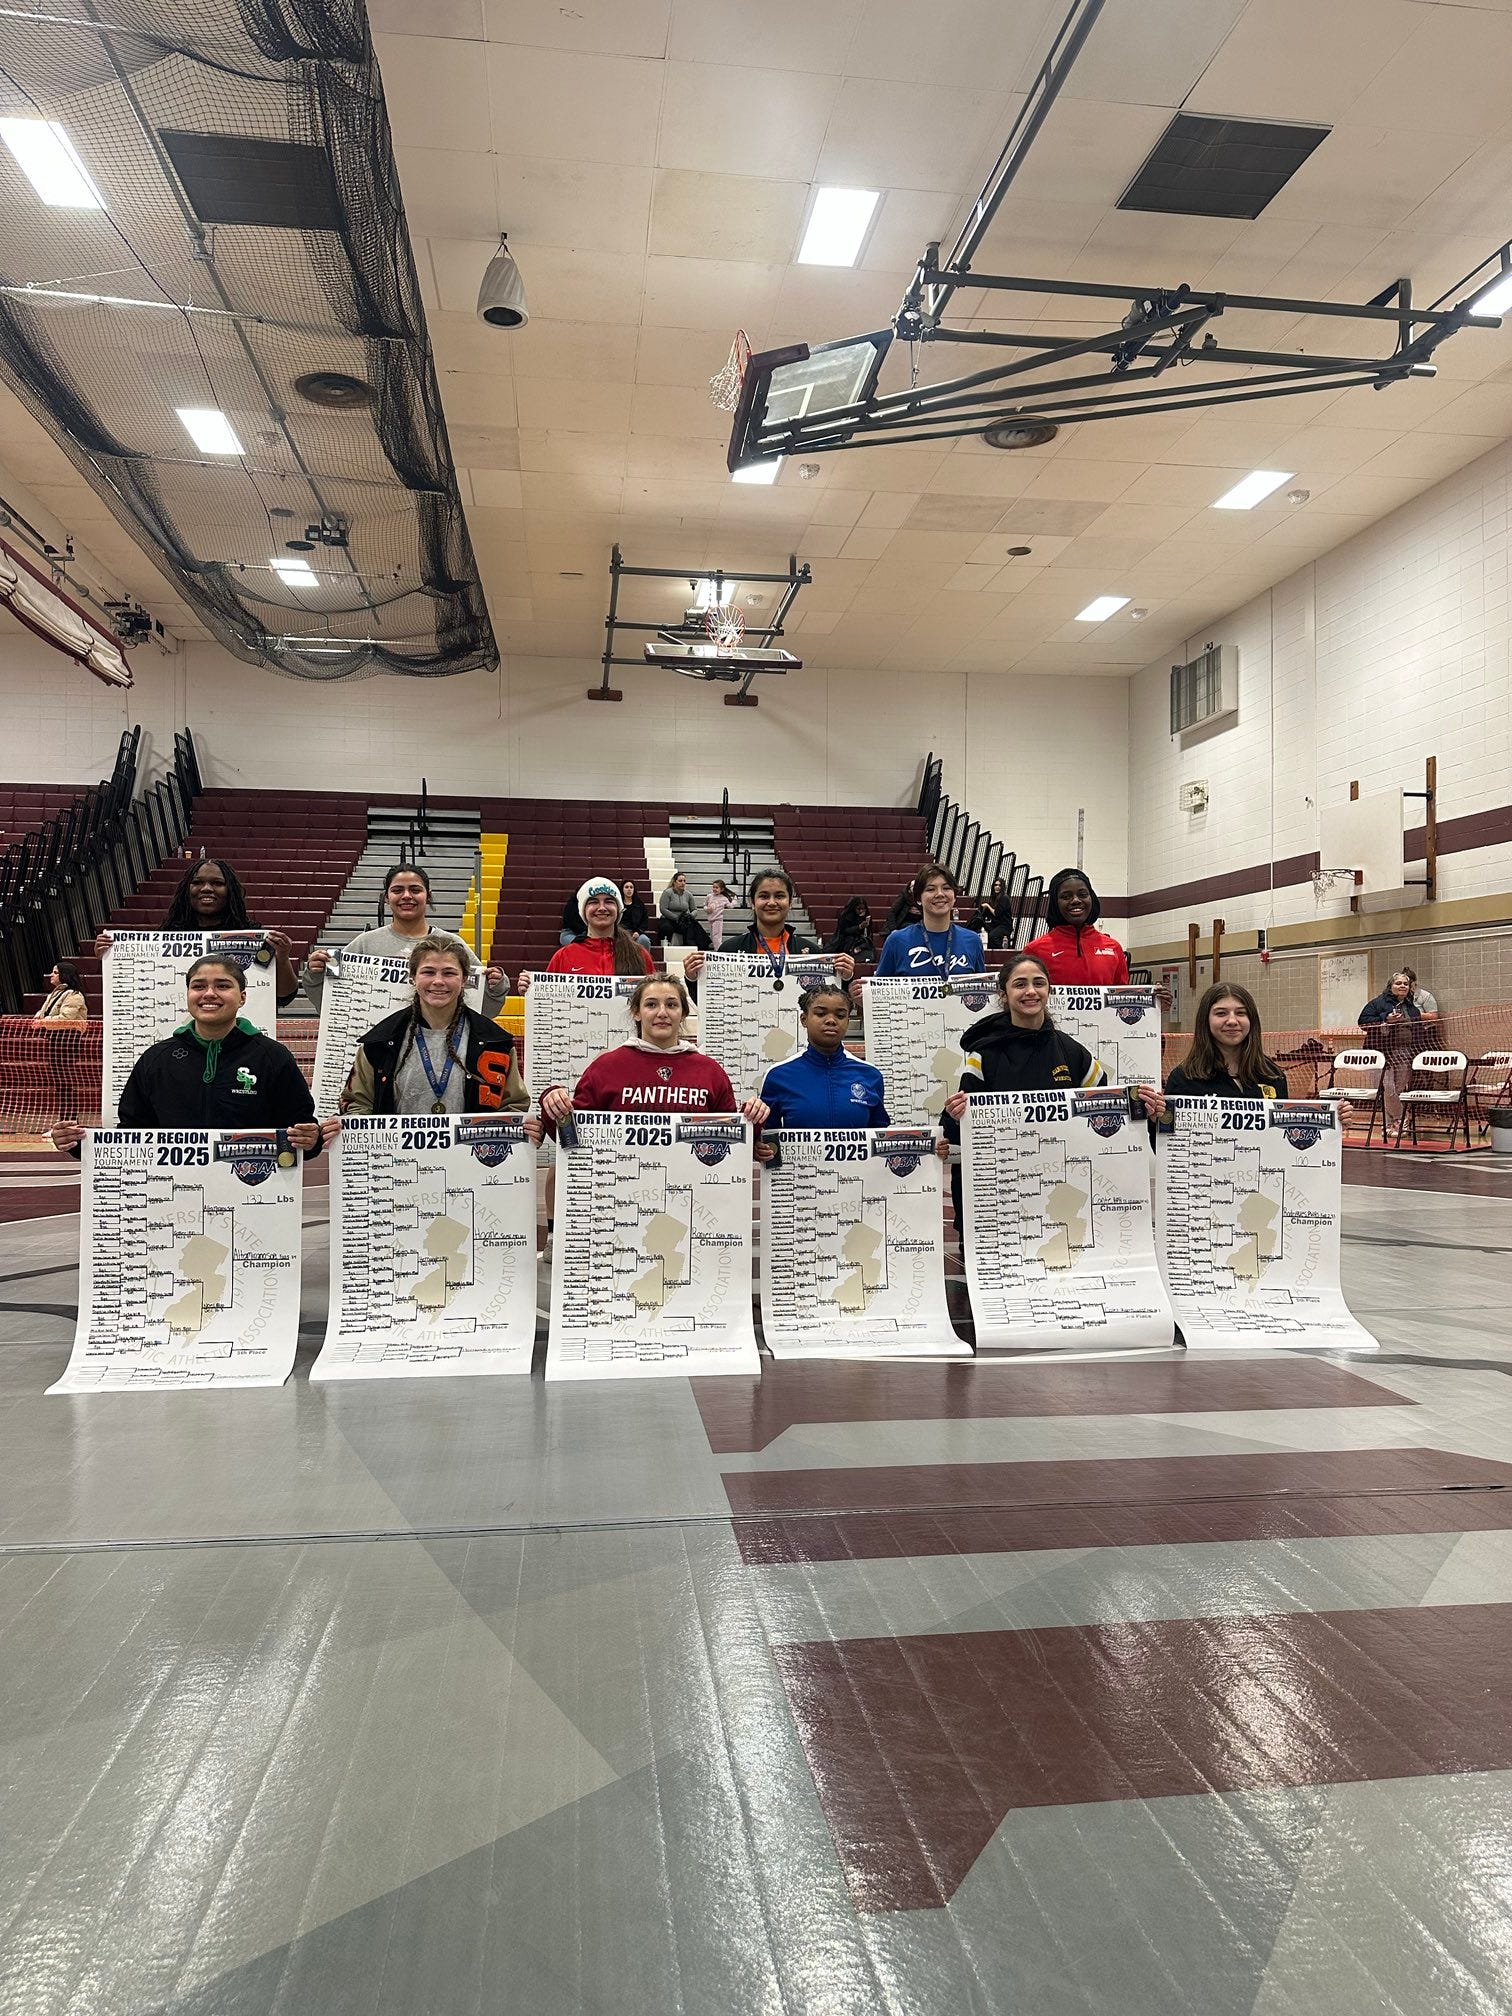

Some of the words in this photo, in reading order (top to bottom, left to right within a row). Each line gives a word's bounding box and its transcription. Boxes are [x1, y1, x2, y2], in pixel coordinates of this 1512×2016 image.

[113, 932, 151, 942] NORTH
[153, 932, 160, 941] 2
[162, 932, 203, 942] REGION
[113, 943, 160, 953] WRESTLING
[162, 942, 204, 958] 2025
[374, 957, 380, 966] 2
[342, 964, 379, 976] RESTLING
[707, 964, 746, 972] WRESTLING
[380, 968, 413, 986] 202
[534, 974, 566, 983] NORTH
[568, 975, 575, 983] 2
[577, 976, 612, 984] REGION
[534, 984, 575, 992] WRESTLING
[577, 985, 613, 999] 2025
[1058, 988, 1064, 996] 2
[1066, 987, 1100, 996] REGION
[1067, 997, 1102, 1011] 2025
[1107, 995, 1152, 1004] WRESTLING
[1343, 1056, 1377, 1065] UNION
[1422, 1056, 1458, 1065] UNION
[621, 1086, 709, 1106] PANTHERS
[970, 1094, 1010, 1106] NORTH
[1012, 1094, 1020, 1104] 2
[1023, 1092, 1066, 1104] REGION
[1074, 1099, 1128, 1114] WRESTLIN
[1176, 1098, 1208, 1110] ORTH
[1210, 1099, 1218, 1110] 2
[1221, 1100, 1264, 1112] REGION
[971, 1106, 1022, 1119] WRESTLING
[1024, 1105, 1069, 1123] 2025
[1176, 1111, 1218, 1123] RESTLING
[1273, 1112, 1331, 1124] WRESTLING
[342, 1118, 386, 1130] NORTH
[389, 1118, 398, 1129] 2
[402, 1117, 450, 1128] REGION
[614, 1114, 622, 1125] 2
[626, 1114, 671, 1126] REGION
[972, 1117, 1022, 1126] TOURNAMENT
[1221, 1112, 1265, 1130] 2025
[342, 1131, 398, 1143] WRESTLING
[459, 1125, 525, 1139] WRESTLING
[577, 1127, 623, 1138] RESTLING
[680, 1125, 742, 1138] WRESTLING
[780, 1131, 811, 1142] ORTH
[814, 1131, 821, 1142] 2
[825, 1131, 867, 1142] REGION
[94, 1132, 141, 1144] NORTH
[145, 1132, 153, 1144] 2
[157, 1132, 209, 1144] REGION
[402, 1131, 451, 1150] 2025
[626, 1128, 673, 1147] 2025
[781, 1144, 822, 1154] RESTLING
[875, 1139, 932, 1152] WRESTLING
[94, 1147, 154, 1158] WRESTLING
[157, 1146, 210, 1166] 2025
[825, 1143, 868, 1161] 2025
[514, 1175, 530, 1184] Lbs
[732, 1176, 747, 1184] Lbs
[922, 1185, 937, 1193] Lbs
[278, 1196, 295, 1204] Lbs
[1100, 1204, 1142, 1213] Champion
[1290, 1218, 1333, 1227] Champion
[482, 1239, 528, 1248] Champion
[700, 1239, 743, 1248] Champion
[894, 1245, 935, 1253] Champion
[243, 1260, 291, 1270] Champion
